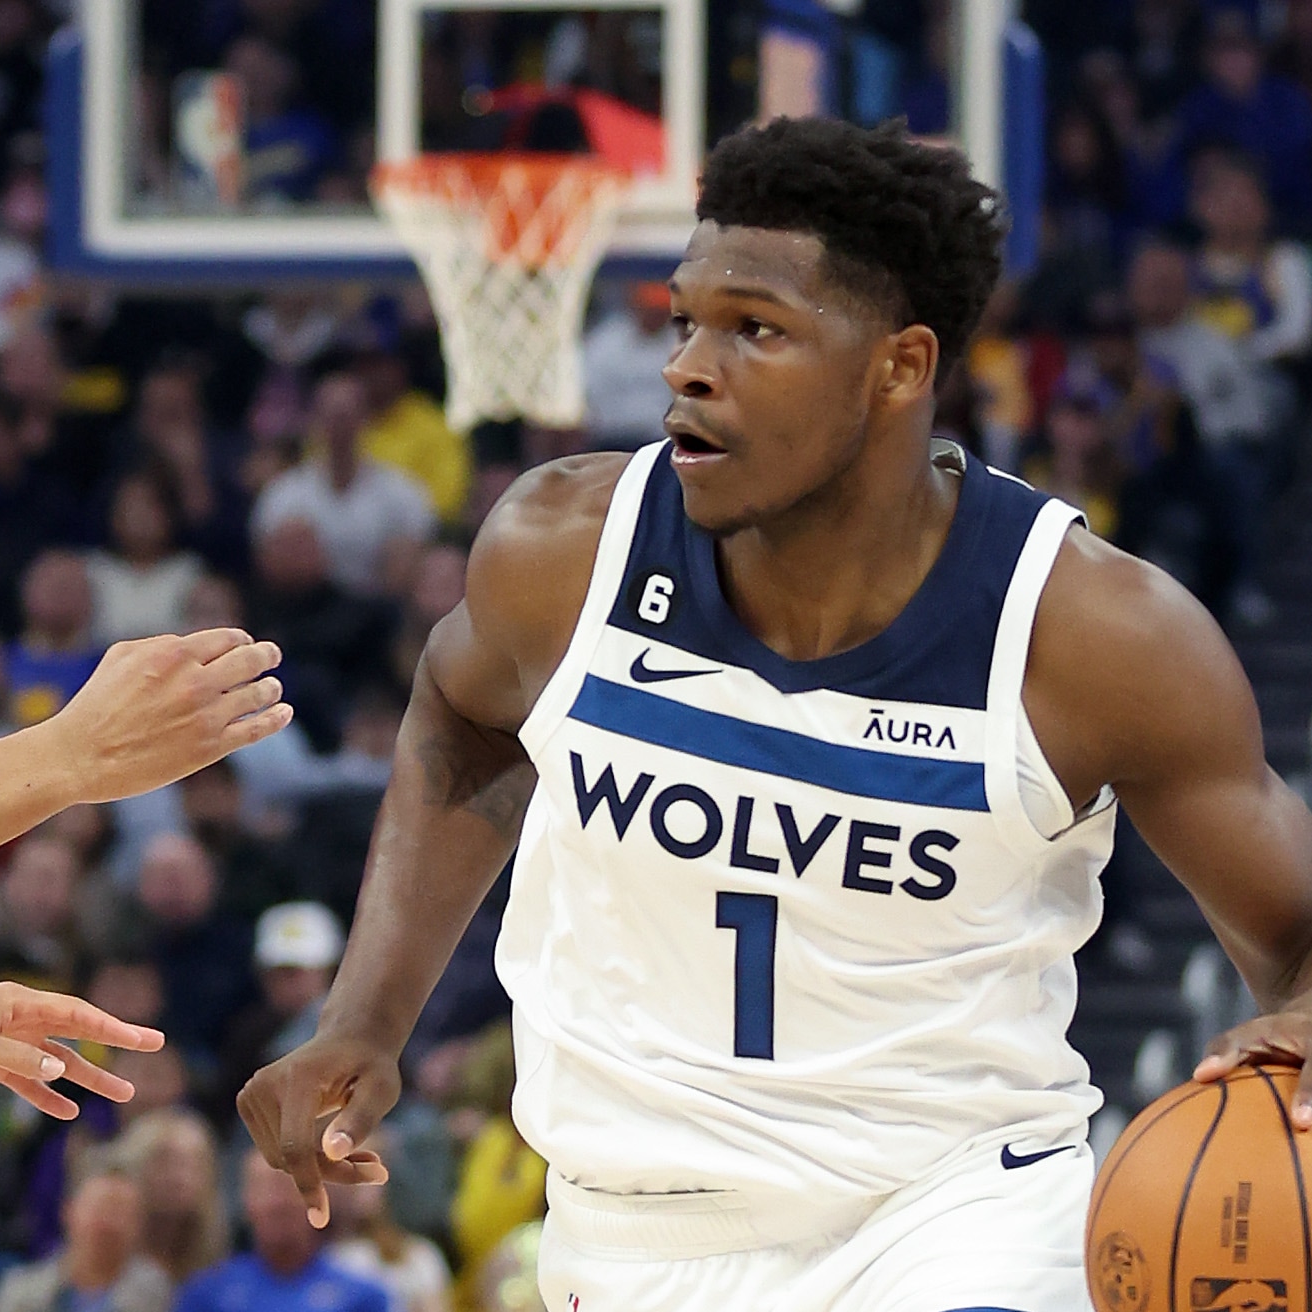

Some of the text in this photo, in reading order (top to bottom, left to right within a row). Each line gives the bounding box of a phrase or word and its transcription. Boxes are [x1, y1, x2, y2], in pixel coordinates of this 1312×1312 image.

[638, 574, 675, 624] 6
[569, 749, 961, 901] WOLVES
[715, 890, 779, 1061] 1
